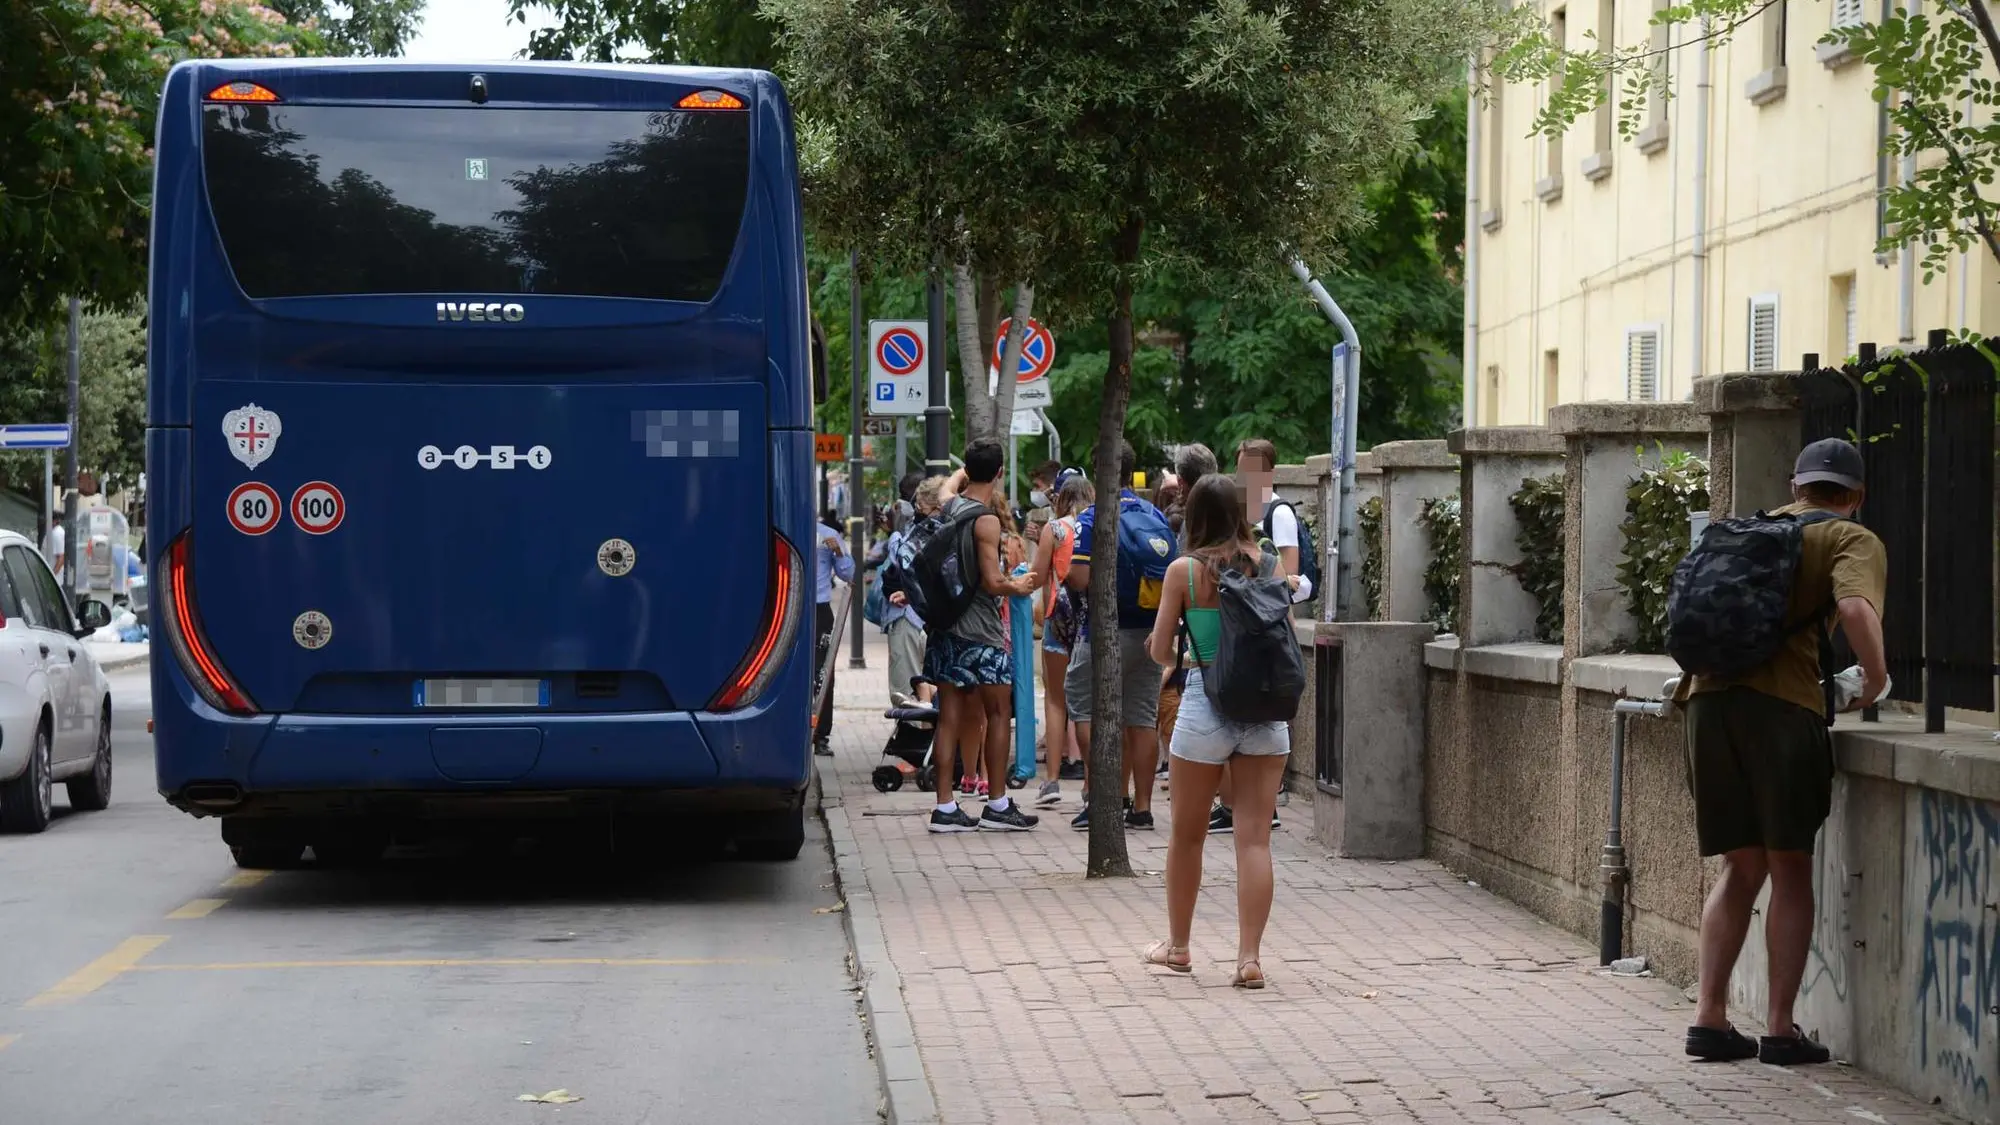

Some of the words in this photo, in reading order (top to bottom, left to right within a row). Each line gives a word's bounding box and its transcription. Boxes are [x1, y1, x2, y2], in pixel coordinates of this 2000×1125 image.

[436, 302, 524, 321] IVECO
[879, 384, 892, 399] P
[815, 440, 841, 453] AXI
[422, 448, 546, 466] arst
[241, 498, 267, 519] 80
[301, 498, 336, 519] 100
